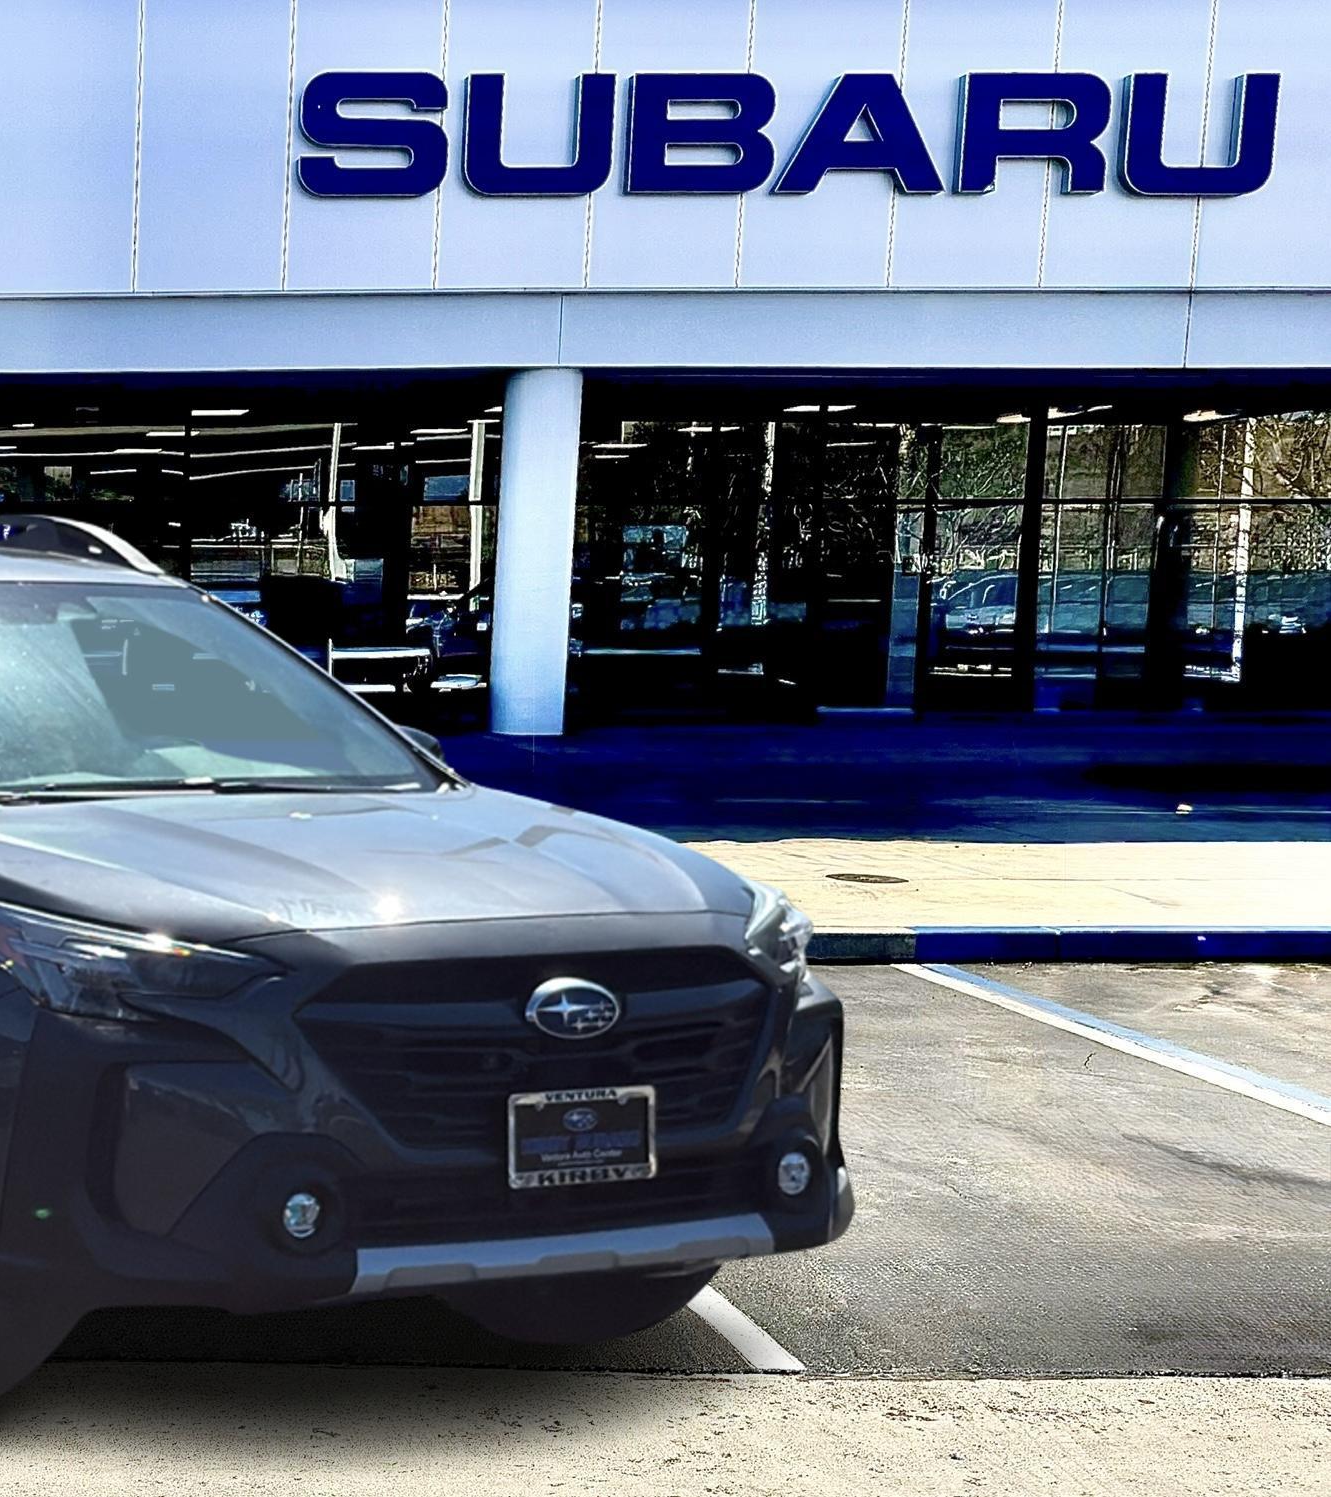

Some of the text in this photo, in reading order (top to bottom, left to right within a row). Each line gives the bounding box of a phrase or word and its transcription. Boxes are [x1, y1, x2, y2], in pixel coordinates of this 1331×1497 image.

[296, 71, 1282, 198] SUBARU
[545, 1089, 616, 1102] VENTURA
[538, 1167, 627, 1185] KIRBY
